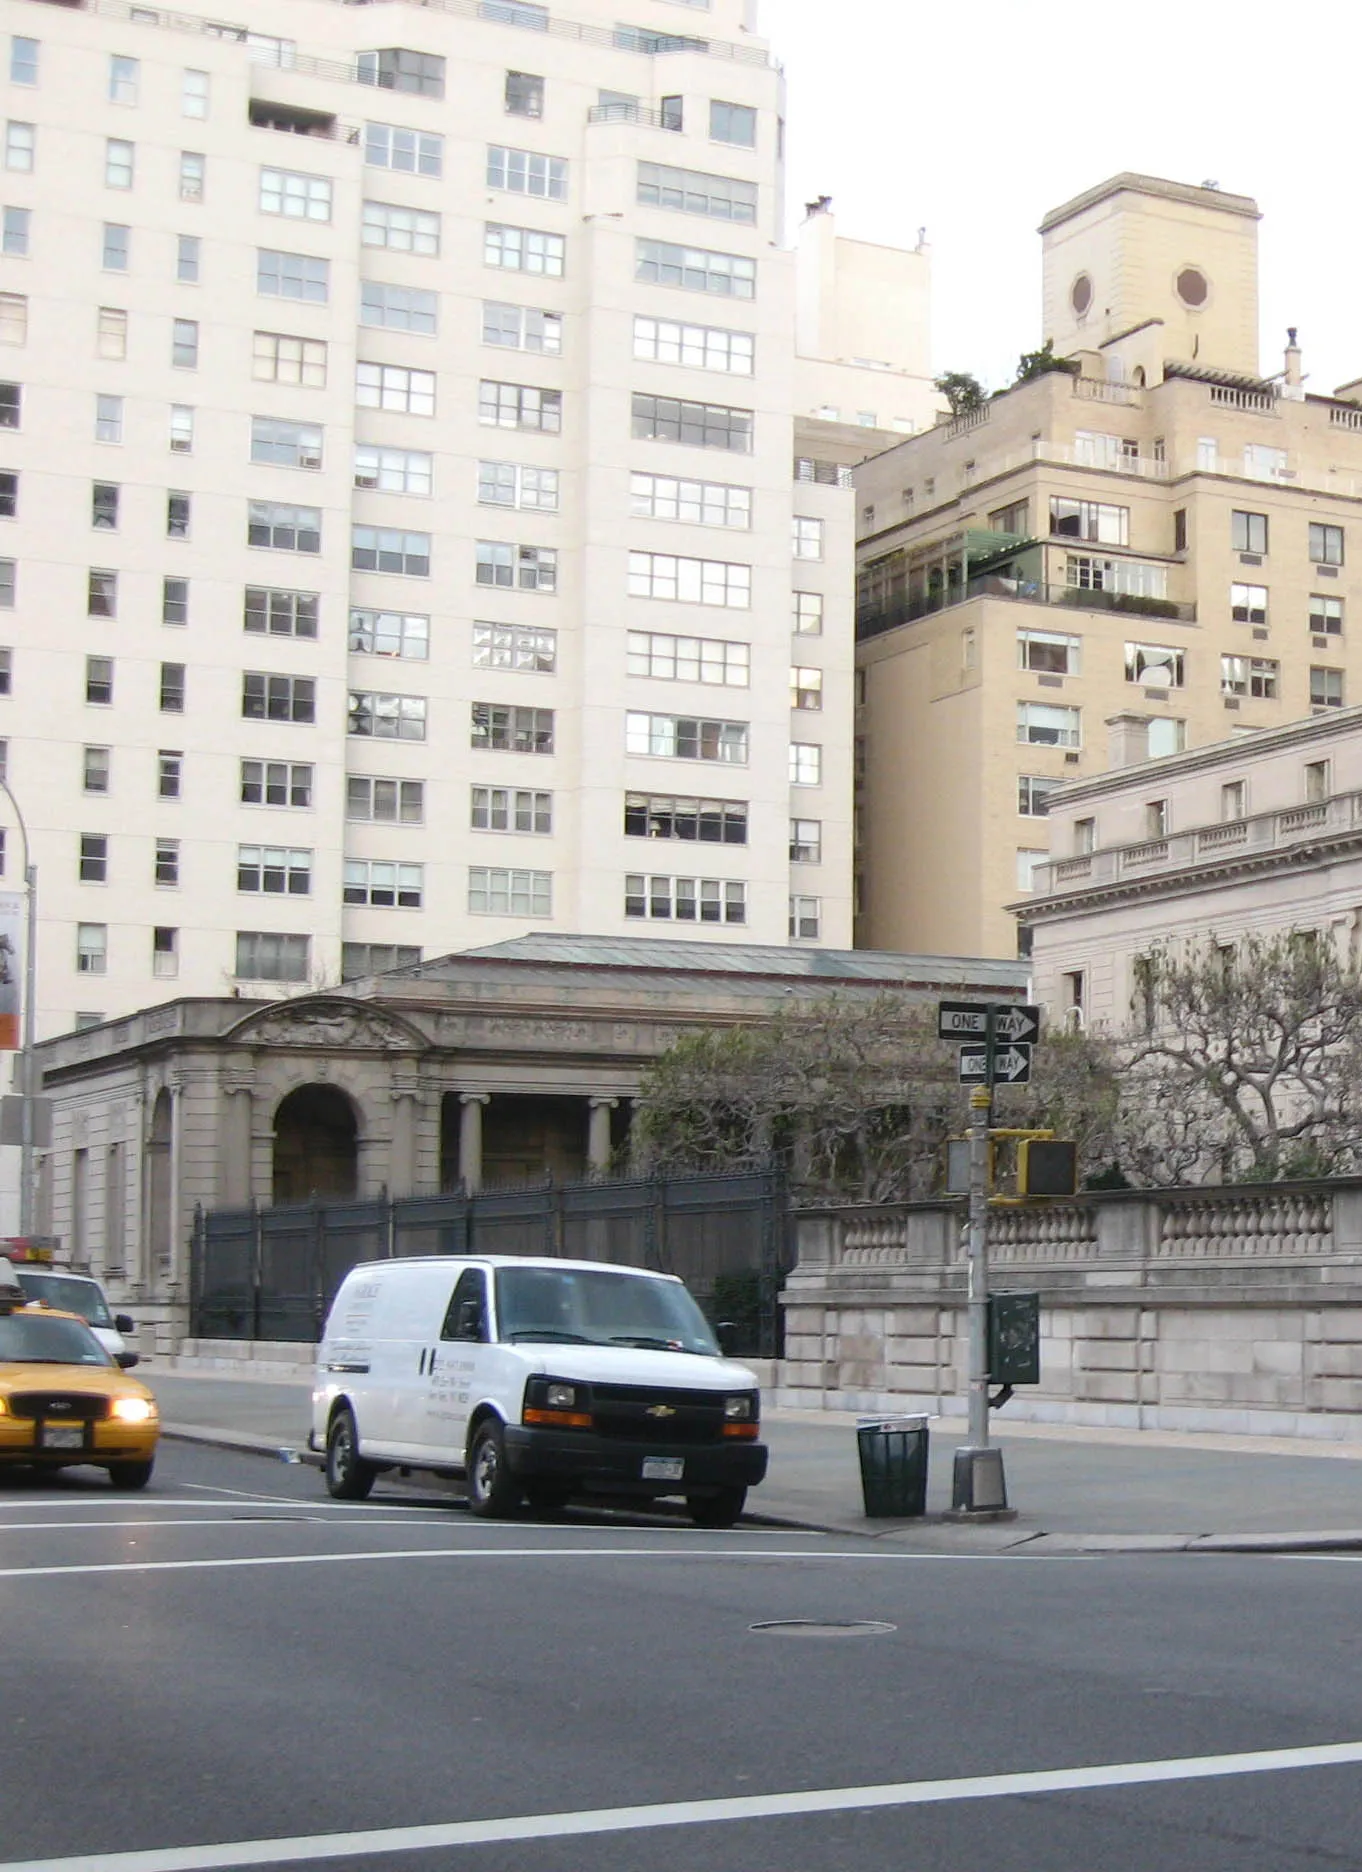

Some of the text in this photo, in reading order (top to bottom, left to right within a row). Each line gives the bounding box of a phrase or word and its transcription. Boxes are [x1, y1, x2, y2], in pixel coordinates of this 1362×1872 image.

[951, 1013, 1025, 1032] ONE WAY
[967, 1056, 1020, 1072] ONE WAY
